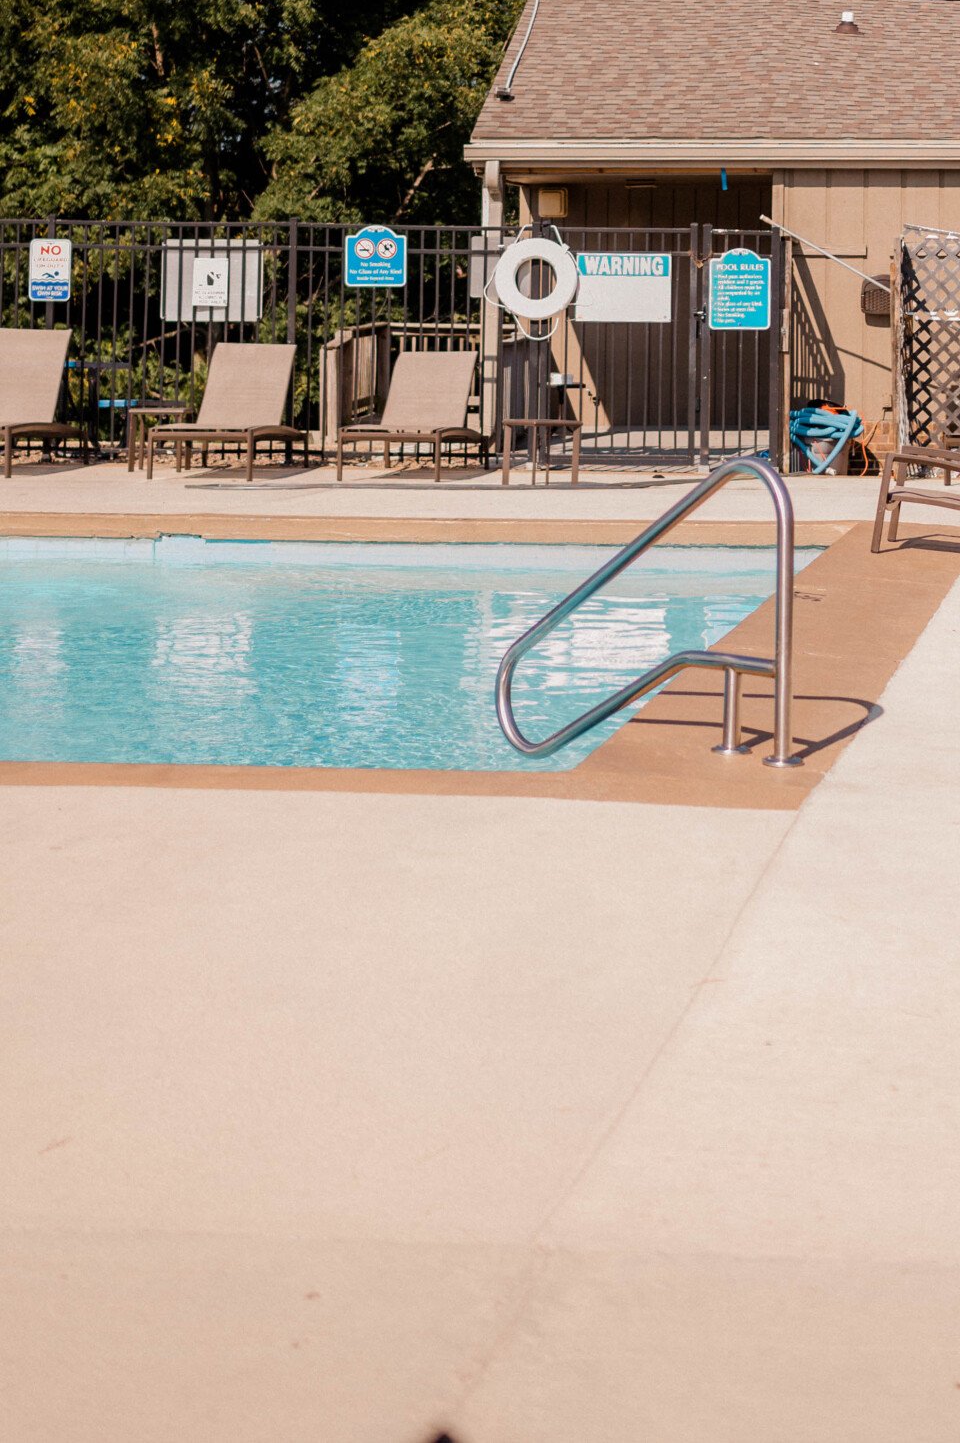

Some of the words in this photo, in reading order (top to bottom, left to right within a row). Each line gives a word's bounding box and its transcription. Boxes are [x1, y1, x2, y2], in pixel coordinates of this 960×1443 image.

[40, 245, 62, 256] NO
[583, 255, 664, 276] WARNING
[716, 263, 739, 271] POOL
[740, 263, 764, 271] RULES
